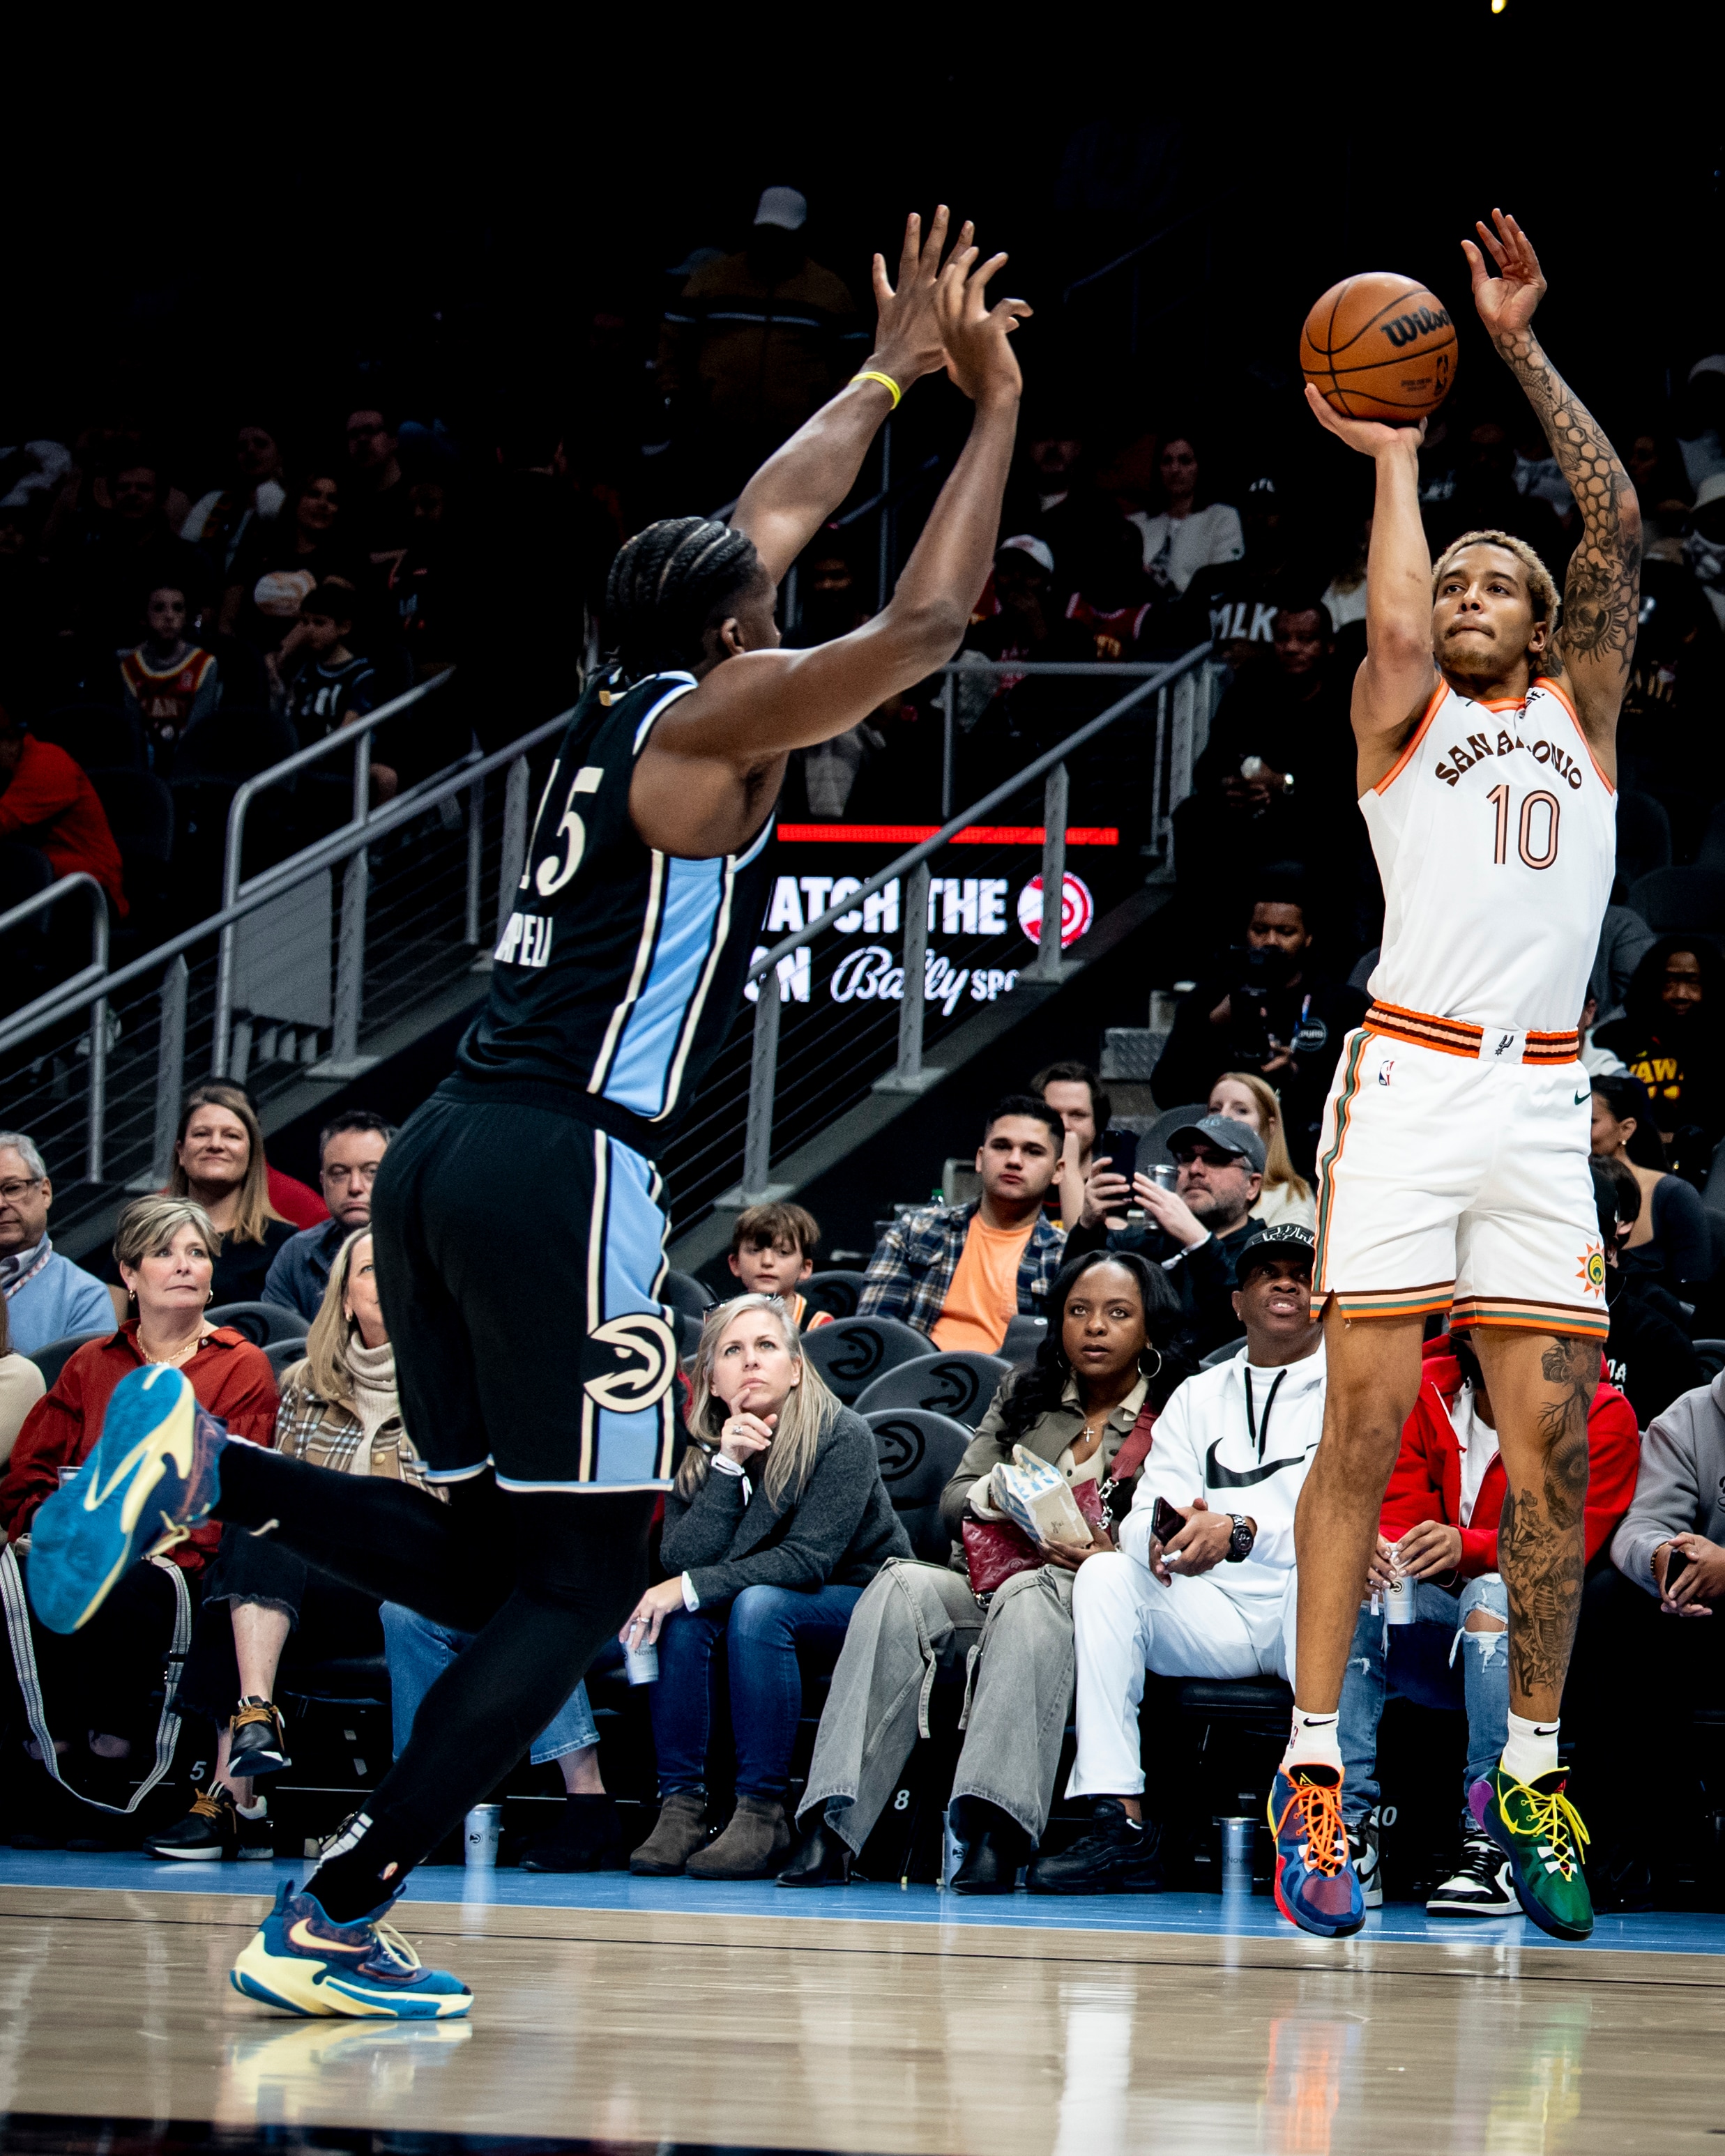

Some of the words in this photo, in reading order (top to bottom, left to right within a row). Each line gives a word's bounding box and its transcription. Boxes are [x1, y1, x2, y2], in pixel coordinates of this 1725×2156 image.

[1380, 306, 1453, 347] Wilso
[1208, 602, 1279, 643] MLK
[1435, 733, 1494, 787] SAN
[1497, 729, 1582, 790] AONIO
[1486, 784, 1560, 871] 10
[761, 876, 899, 933] ATCH
[830, 946, 970, 1016] Baly
[190, 1761, 207, 1780] 5
[894, 1789, 910, 1810] 8
[1371, 1805, 1397, 1827] 10
